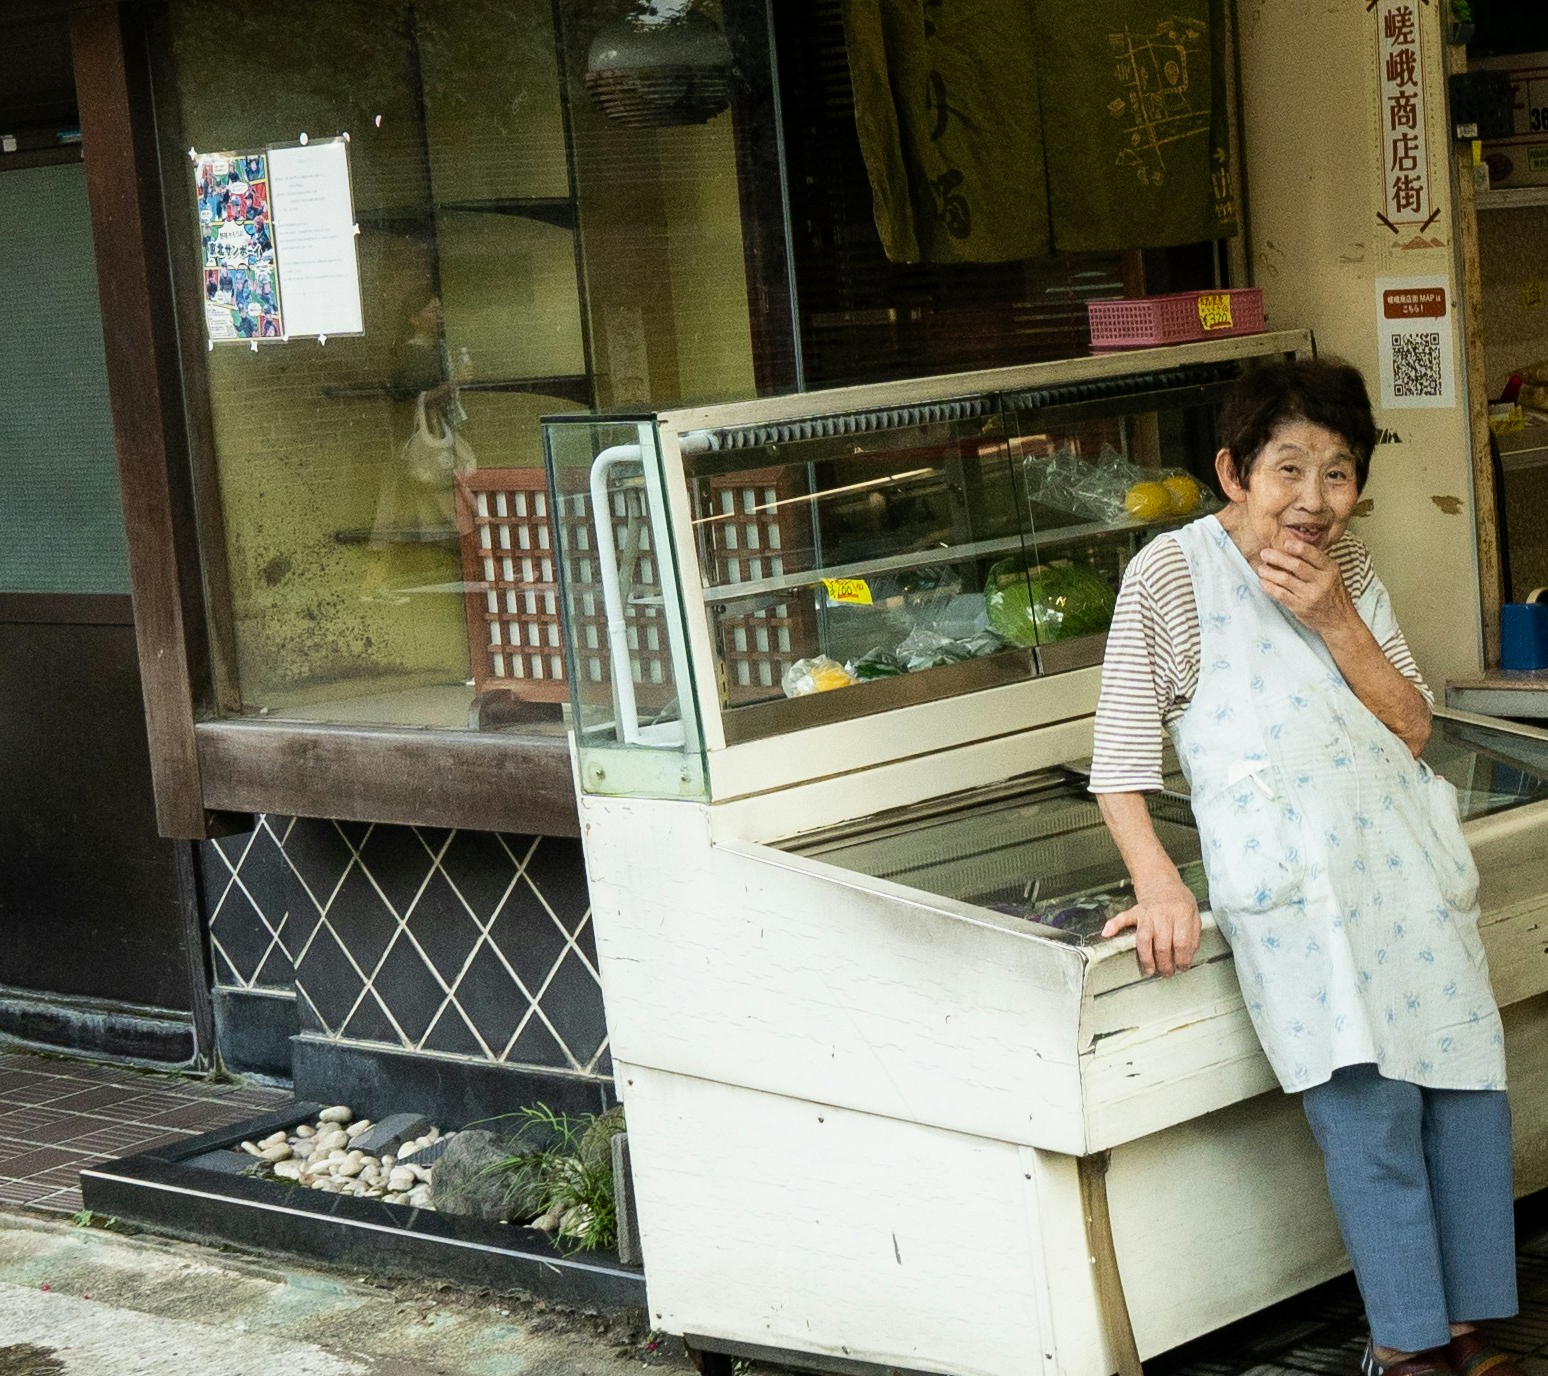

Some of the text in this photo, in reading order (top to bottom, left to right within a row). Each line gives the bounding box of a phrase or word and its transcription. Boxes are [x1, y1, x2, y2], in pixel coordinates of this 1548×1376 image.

[1384, 6, 1423, 213] 嵯峨商店街
[1419, 294, 1434, 303] MAP
